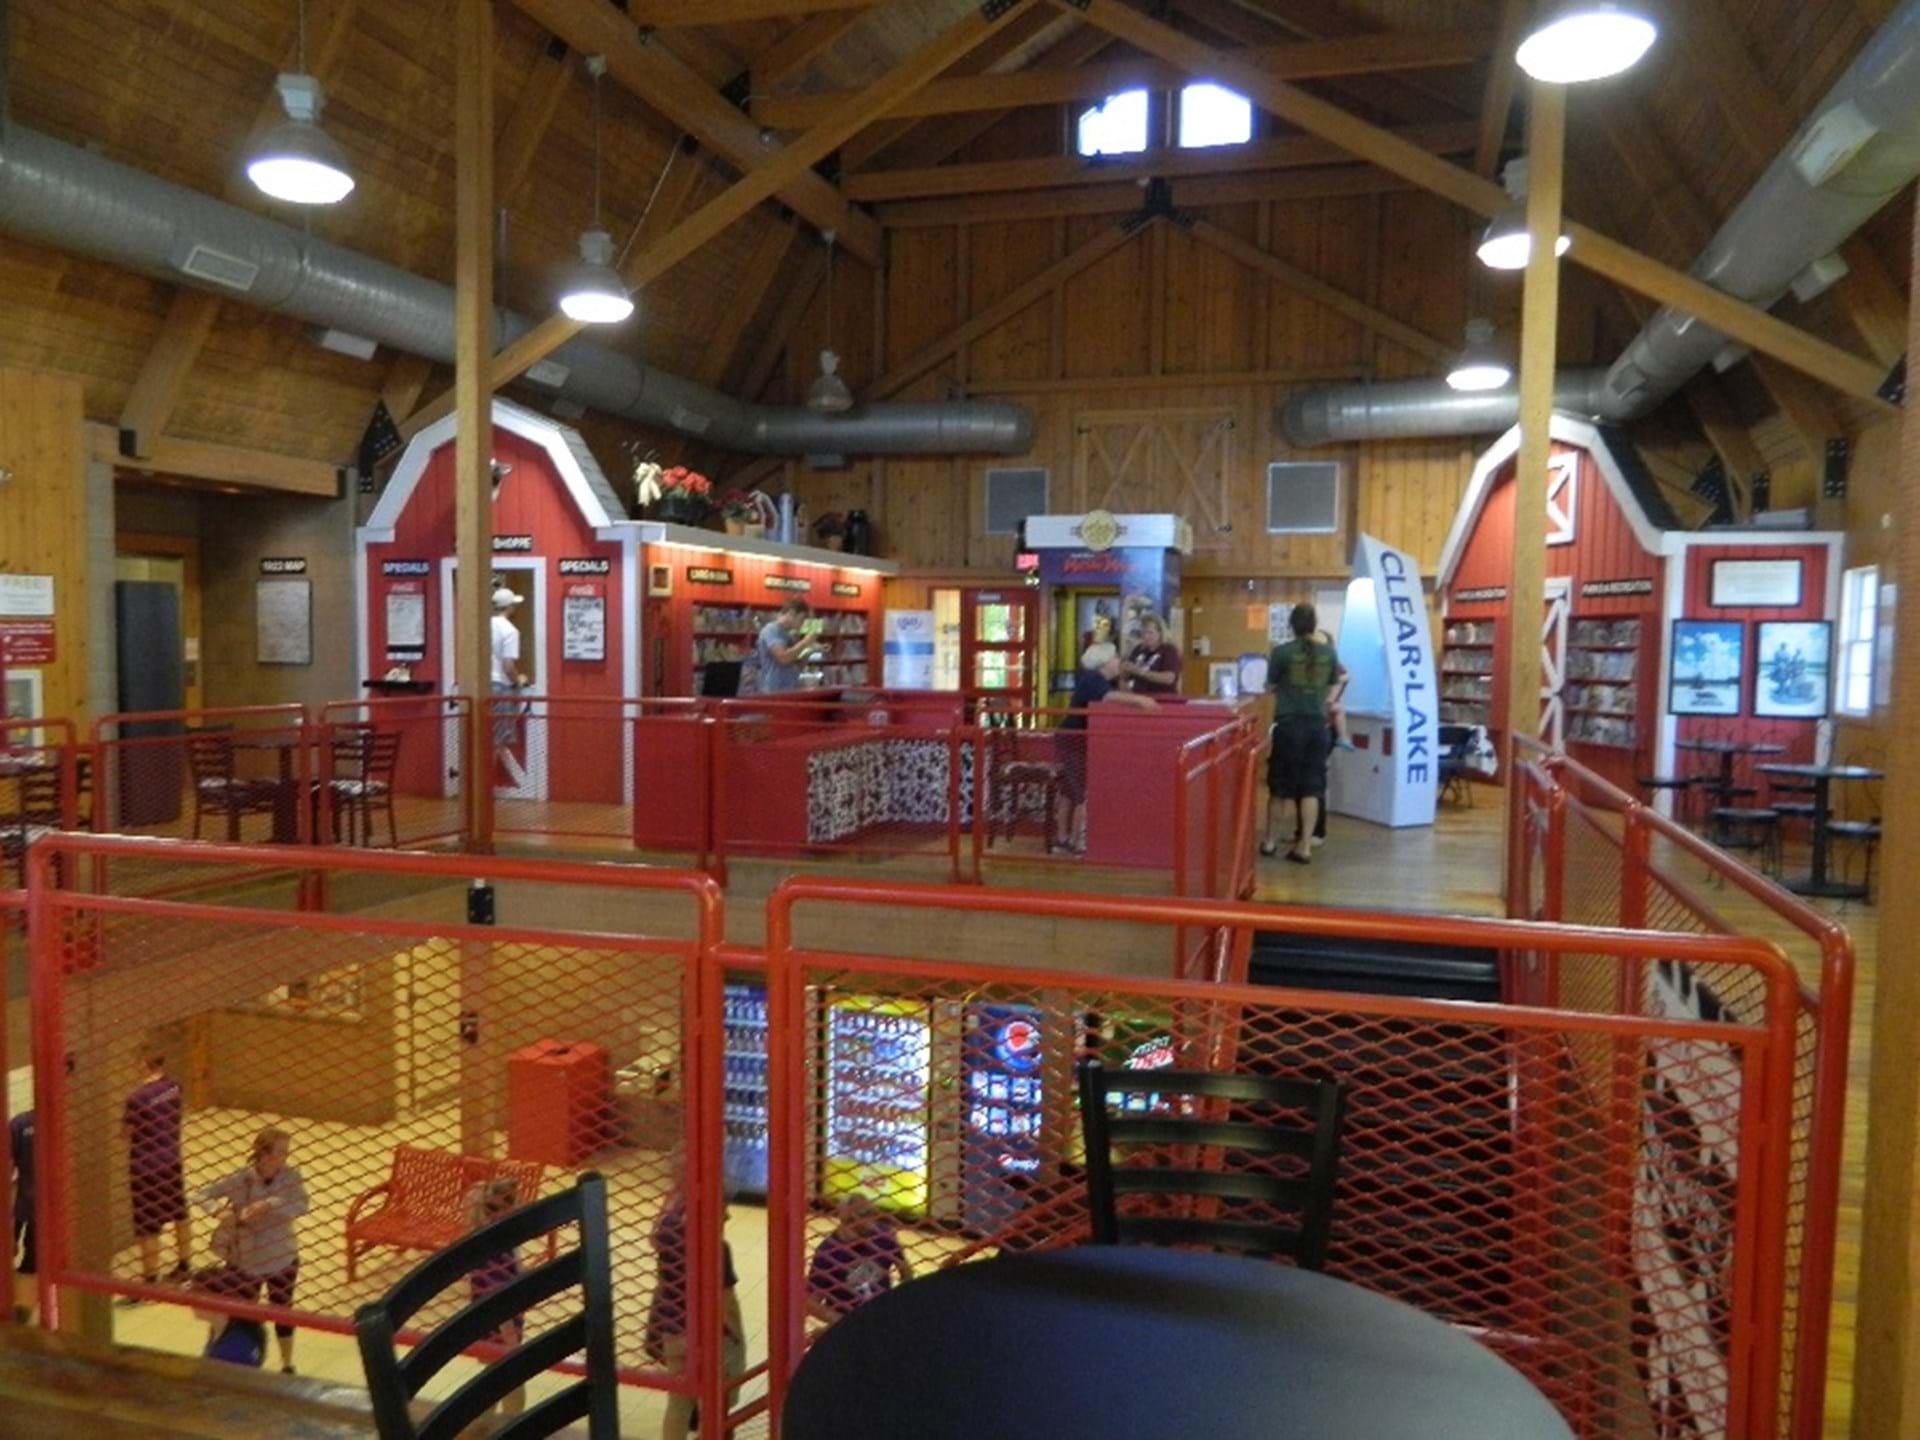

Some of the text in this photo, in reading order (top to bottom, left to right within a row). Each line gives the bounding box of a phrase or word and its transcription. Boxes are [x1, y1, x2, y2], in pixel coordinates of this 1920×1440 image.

[492, 536, 533, 550] SHOPPE
[383, 562, 430, 573] SPECIALS
[559, 560, 609, 573] SPECIALS
[1379, 551, 1428, 784] CLEAR LAKE
